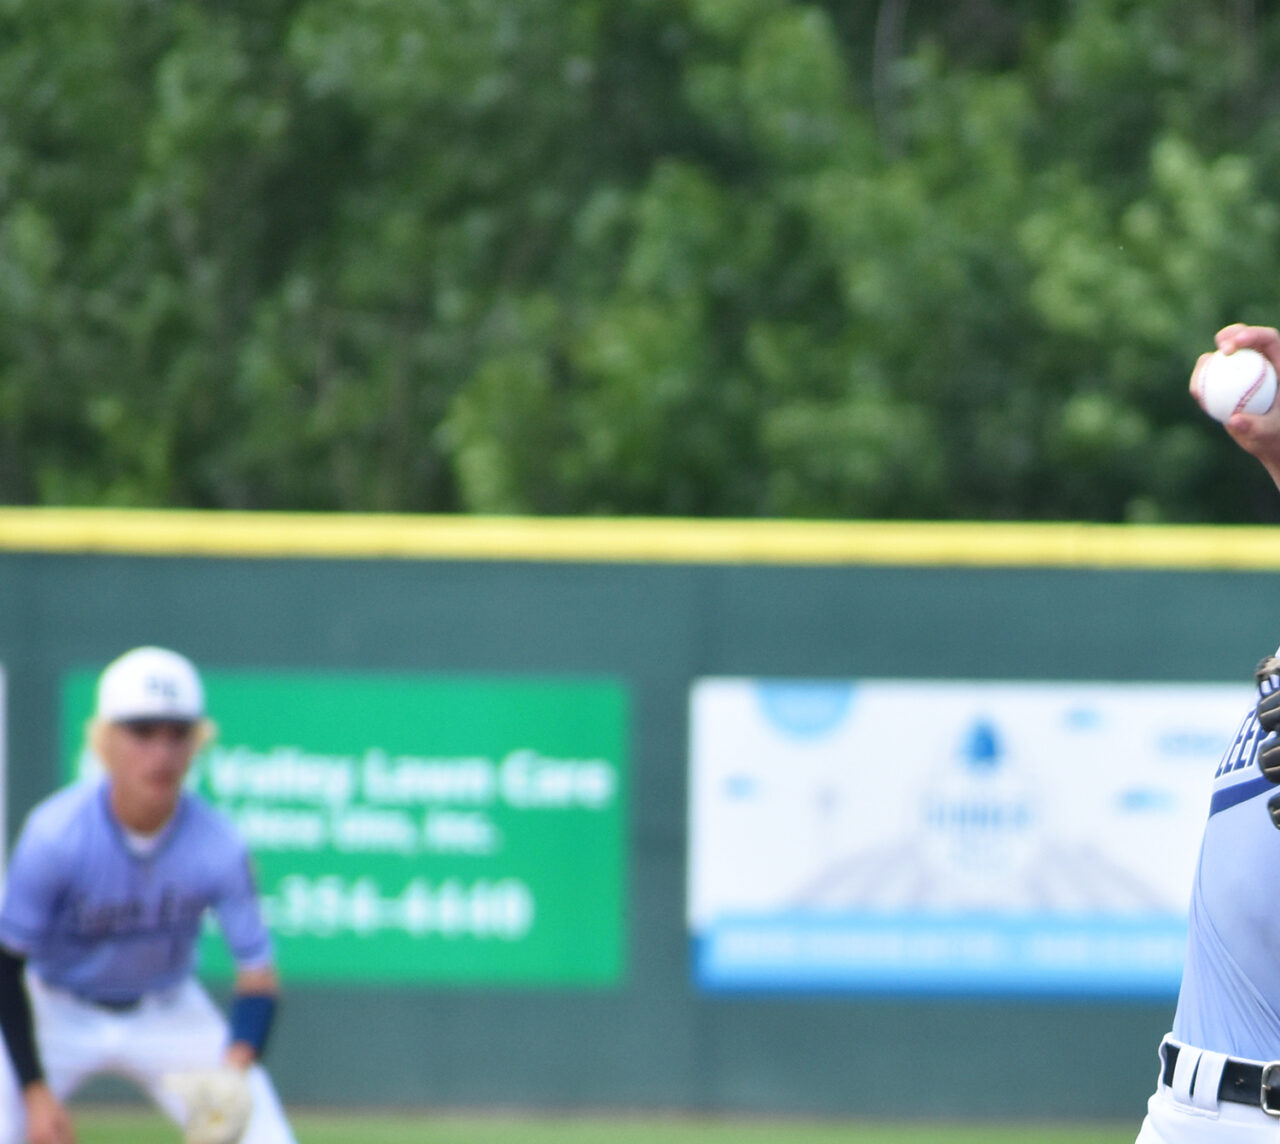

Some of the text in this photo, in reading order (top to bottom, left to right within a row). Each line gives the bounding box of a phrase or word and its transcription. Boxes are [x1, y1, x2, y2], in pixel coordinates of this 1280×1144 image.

[365, 749, 496, 804] Lawn
[502, 750, 616, 808] Care
[263, 876, 534, 939] -354-4440
